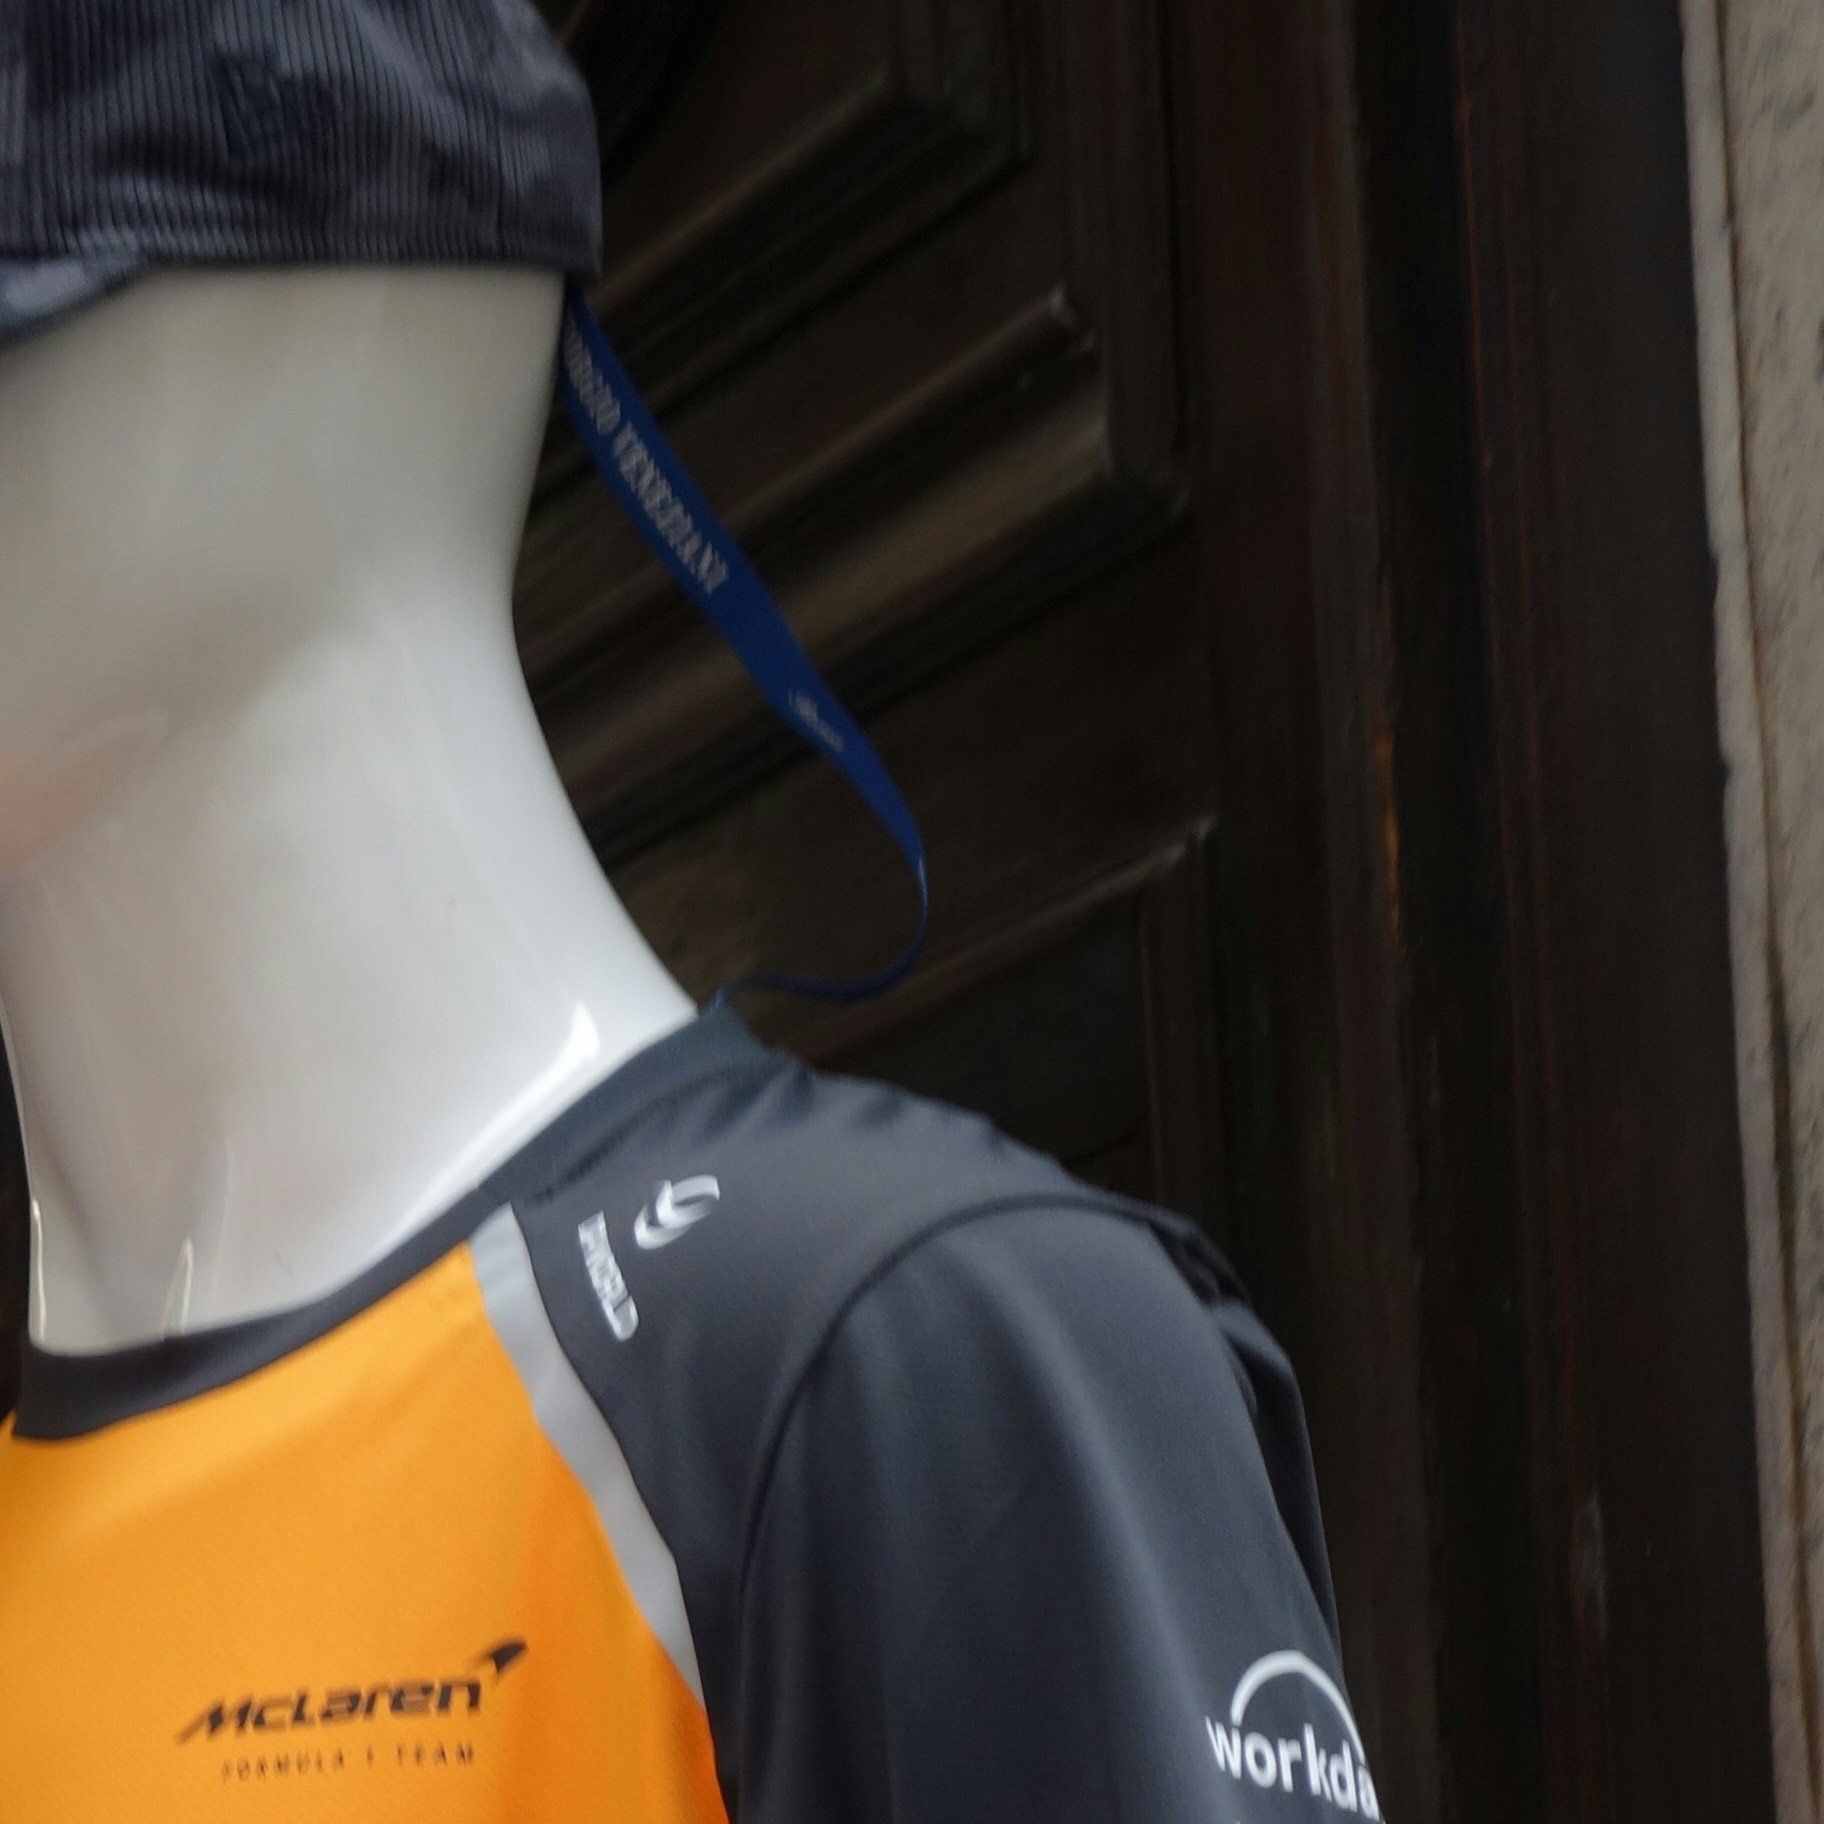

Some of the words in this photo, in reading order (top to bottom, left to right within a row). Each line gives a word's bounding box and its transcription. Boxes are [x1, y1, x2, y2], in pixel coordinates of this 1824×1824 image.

[174, 1677, 482, 1747] McLaren
[220, 1747, 345, 1782] FORMULA
[390, 1740, 475, 1768] TEAM
